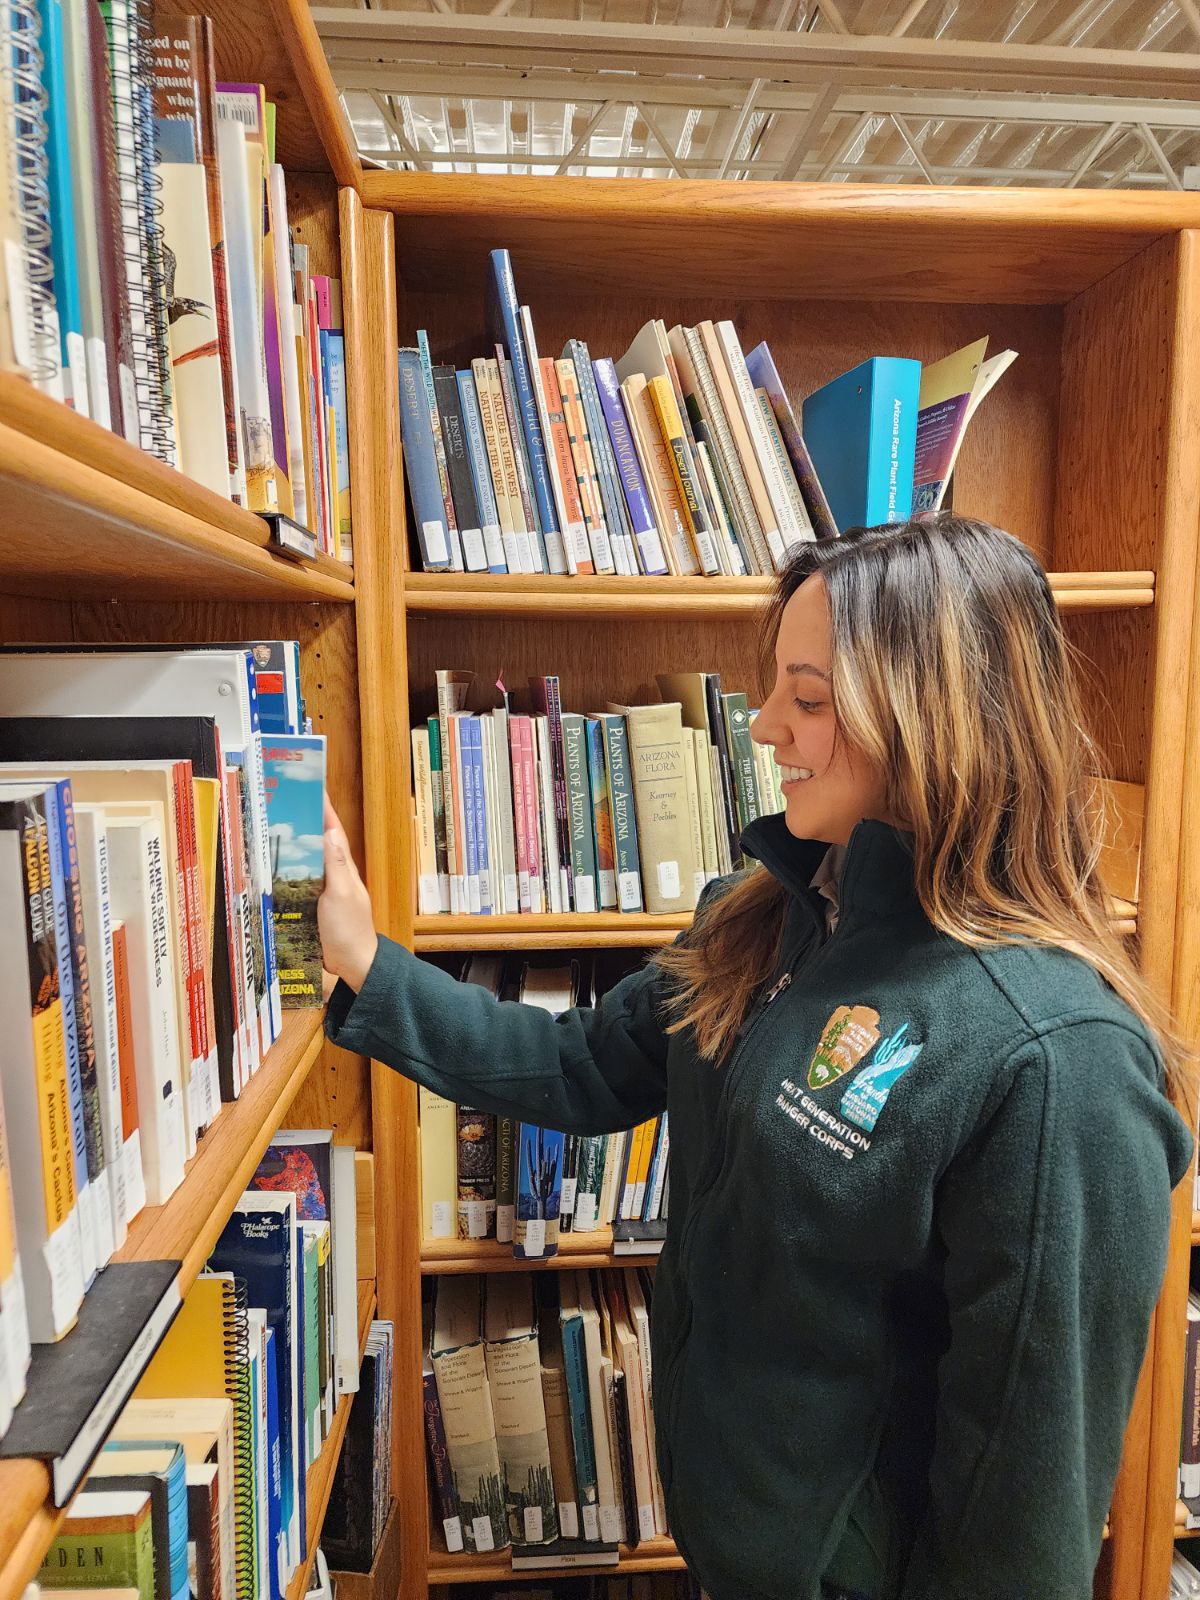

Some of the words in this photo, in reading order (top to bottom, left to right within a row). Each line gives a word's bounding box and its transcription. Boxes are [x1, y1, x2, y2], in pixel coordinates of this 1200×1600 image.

[173, 40, 190, 50] on
[175, 55, 191, 72] by
[167, 93, 194, 107] who
[511, 335, 532, 392] Arizona
[731, 344, 744, 368] Effects
[424, 371, 432, 387] WILD
[739, 368, 747, 377] of
[742, 377, 752, 392] Fire
[427, 388, 438, 426] SOUTHWEST
[464, 383, 474, 413] Radiant
[479, 390, 494, 431] NATURE
[492, 391, 507, 433] NATURE
[747, 392, 755, 403] on
[758, 394, 770, 416] HOW
[523, 397, 539, 431] Wild
[750, 403, 765, 435] Madrean
[765, 416, 773, 427] TO
[891, 398, 902, 435] Arizona
[448, 414, 465, 459] DESERTS
[486, 433, 496, 445] IN
[500, 435, 509, 447] IN
[530, 435, 543, 448] &
[555, 428, 566, 453] Southern
[760, 434, 775, 466] Province
[768, 427, 784, 459] IDENTIFY
[890, 436, 899, 458] Rare
[473, 437, 484, 472] WRITINGS
[488, 447, 500, 467] THE
[502, 449, 513, 469] THE
[533, 452, 550, 483] Free
[560, 454, 570, 475] Arizona
[609, 417, 640, 493] DOWNCANYON
[652, 441, 673, 481] Desert
[479, 473, 486, 482] BY
[492, 468, 505, 497] WEST
[506, 470, 519, 499] WEST
[564, 477, 574, 495] Nature
[672, 443, 690, 476] Desert
[681, 476, 701, 512] Journal
[770, 466, 787, 505] Ecosystems
[779, 459, 793, 487] PLANTS
[888, 460, 898, 485] Plant
[480, 484, 490, 504] ENOS
[887, 486, 896, 509] Field
[484, 503, 494, 526] MILLS
[439, 708, 447, 727] Cover
[416, 740, 424, 761] Desert
[440, 729, 448, 748] Types
[441, 749, 448, 757] of
[566, 726, 582, 769] PLANTS
[609, 726, 625, 769] PLANTS
[639, 750, 680, 762] ARIZONA
[645, 762, 676, 773] FLORA
[742, 756, 751, 774] THE
[463, 765, 471, 789] Flowers
[473, 765, 481, 789] Flowers
[513, 762, 521, 784] Flowers
[523, 760, 531, 784] Flowers
[569, 771, 583, 786] OF
[612, 771, 626, 786] OF
[649, 791, 677, 801] Kearney
[744, 774, 755, 803] JEPSON
[516, 804, 524, 835] Southwest
[570, 789, 586, 840] ARIZONA
[614, 789, 630, 840] ARIZONA
[653, 811, 677, 822] Peebles
[661, 801, 668, 809] &
[747, 803, 757, 821] DES
[466, 809, 474, 841] Southwest
[476, 808, 484, 841] Southwest
[526, 805, 534, 838] Southwest
[146, 839, 153, 853] IN
[446, 827, 454, 852] Canada
[97, 835, 109, 894] TUCSON
[151, 836, 163, 903] WALKING
[477, 842, 485, 870] Mountain
[575, 849, 583, 865] ANNE
[619, 849, 627, 865] ANNE
[147, 857, 155, 889] THE
[177, 871, 186, 927] DESERT
[192, 863, 201, 920] DESERT
[55, 900, 68, 936] On
[62, 786, 84, 934] CROSSING
[76, 943, 97, 1068] ARIZONA
[101, 901, 112, 956] HIKING
[156, 906, 167, 958] SOFTLY
[185, 866, 194, 920] DESERT
[190, 924, 198, 973] SENSE
[150, 891, 161, 988] WILDERNESS
[180, 929, 189, 977] SENSE
[195, 922, 203, 969] SENSE
[240, 892, 254, 990] ARIZONA
[58, 943, 72, 984] the
[104, 960, 114, 1006] GUIDE
[51, 1011, 65, 1074] Hiking
[63, 993, 82, 1092] Arizona
[107, 1009, 117, 1049] Second
[40, 1023, 55, 1082] Hiking
[109, 1053, 119, 1091] Edition
[56, 1077, 71, 1145] Arizona's
[781, 1078, 804, 1099] NEXT
[801, 1095, 871, 1151] GENERATION
[46, 1092, 61, 1163] Arizona's
[71, 1097, 87, 1157] Trail
[502, 1118, 510, 1135] CTI
[776, 1094, 810, 1129] RANGER
[810, 1125, 855, 1159] CORPS
[501, 1137, 510, 1149] OF
[62, 1149, 75, 1203] Cactus
[500, 1150, 509, 1193] ARIZONA
[51, 1166, 65, 1222] Cactus
[243, 1230, 269, 1239] Books
[467, 1370, 485, 1379] Desert
[495, 1366, 518, 1374] Sonoran
[519, 1362, 536, 1370] Desert
